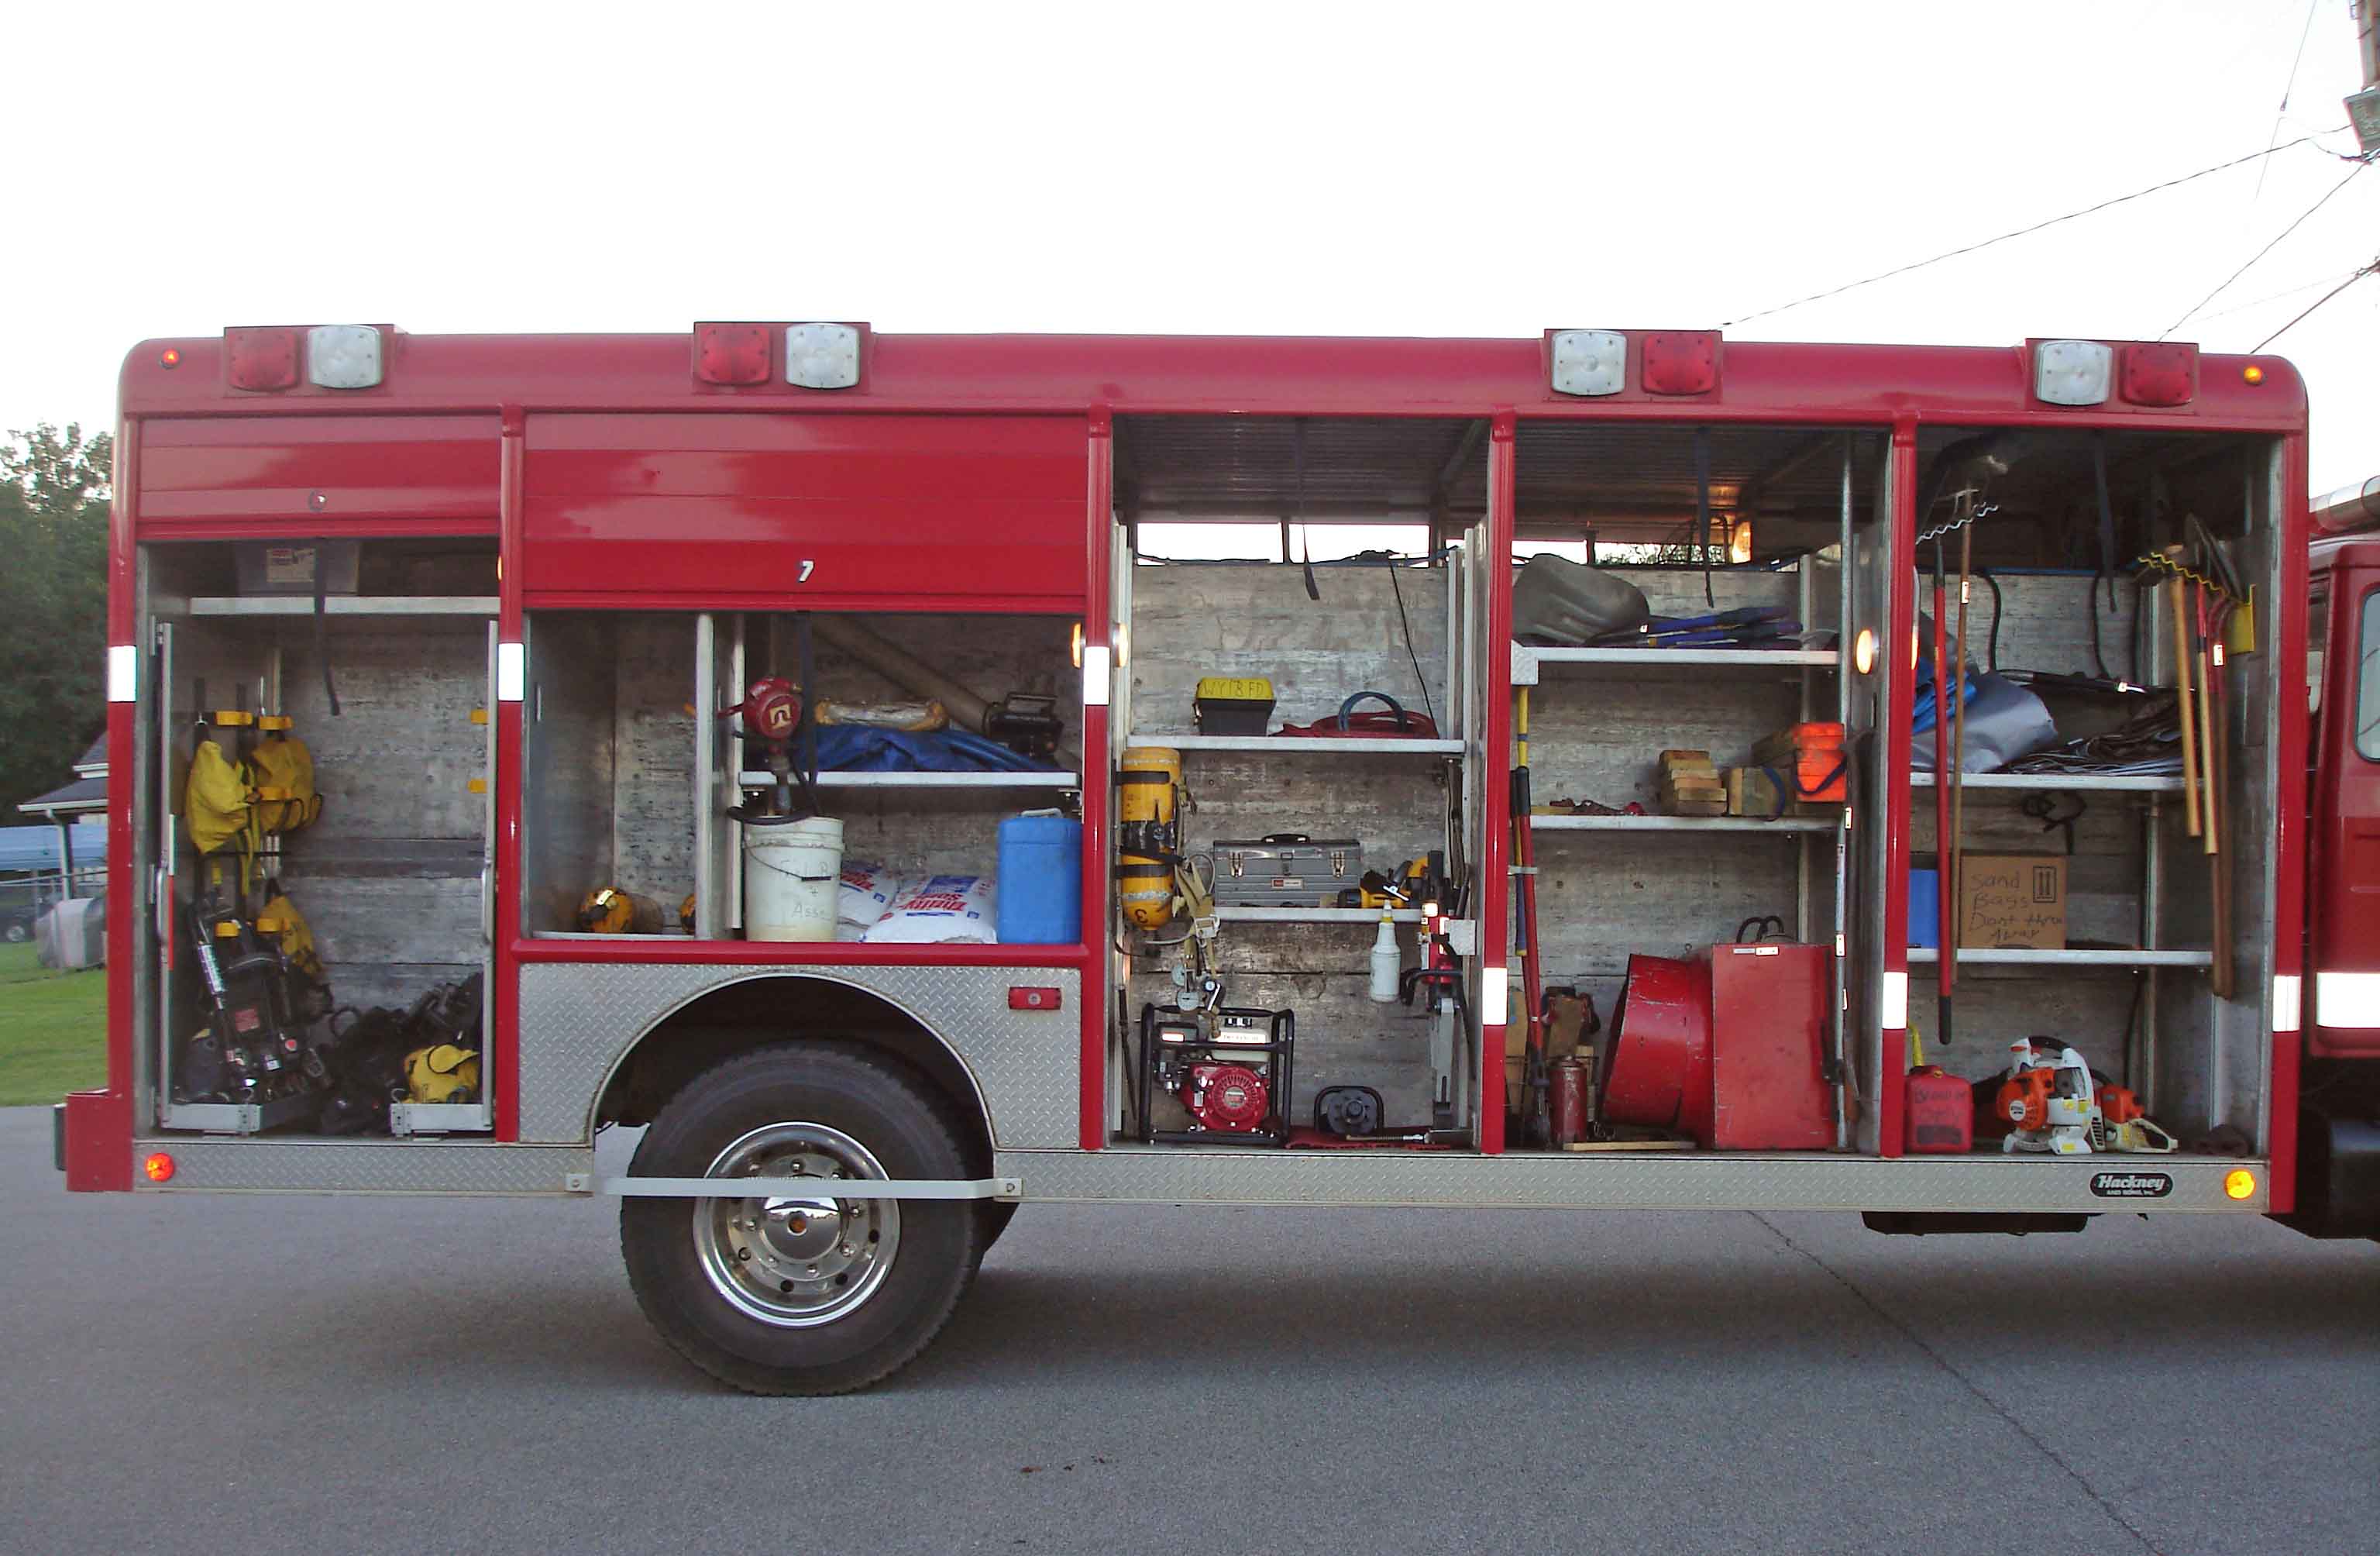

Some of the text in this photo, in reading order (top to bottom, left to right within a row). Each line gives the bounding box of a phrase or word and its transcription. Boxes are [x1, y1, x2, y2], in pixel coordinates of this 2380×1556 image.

[799, 559, 814, 582] 7
[1969, 870, 2020, 891] Sand
[1973, 893, 2028, 911] Bags
[2097, 1175, 2165, 1191] Hackney
